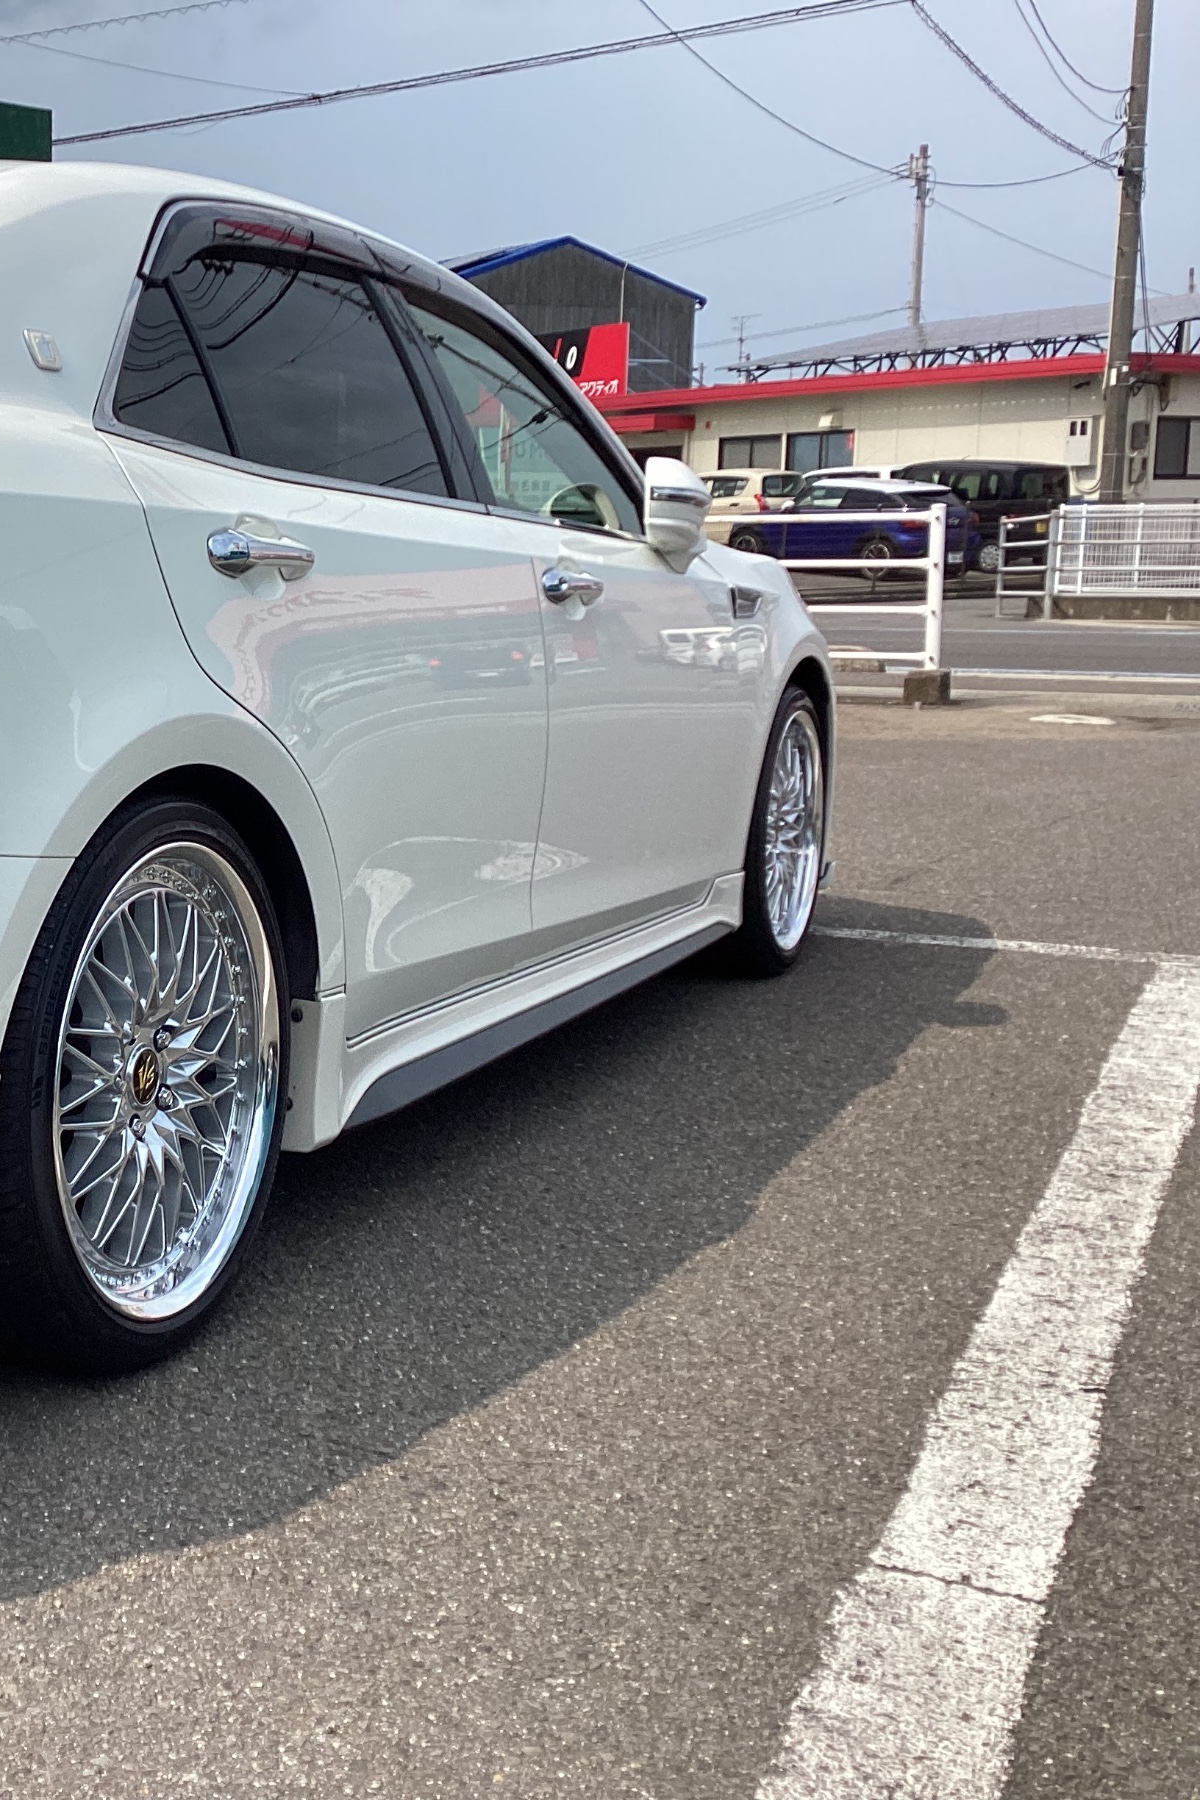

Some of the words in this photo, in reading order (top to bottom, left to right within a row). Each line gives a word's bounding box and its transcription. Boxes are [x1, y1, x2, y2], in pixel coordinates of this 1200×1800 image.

[579, 379, 619, 396] アクティオ
